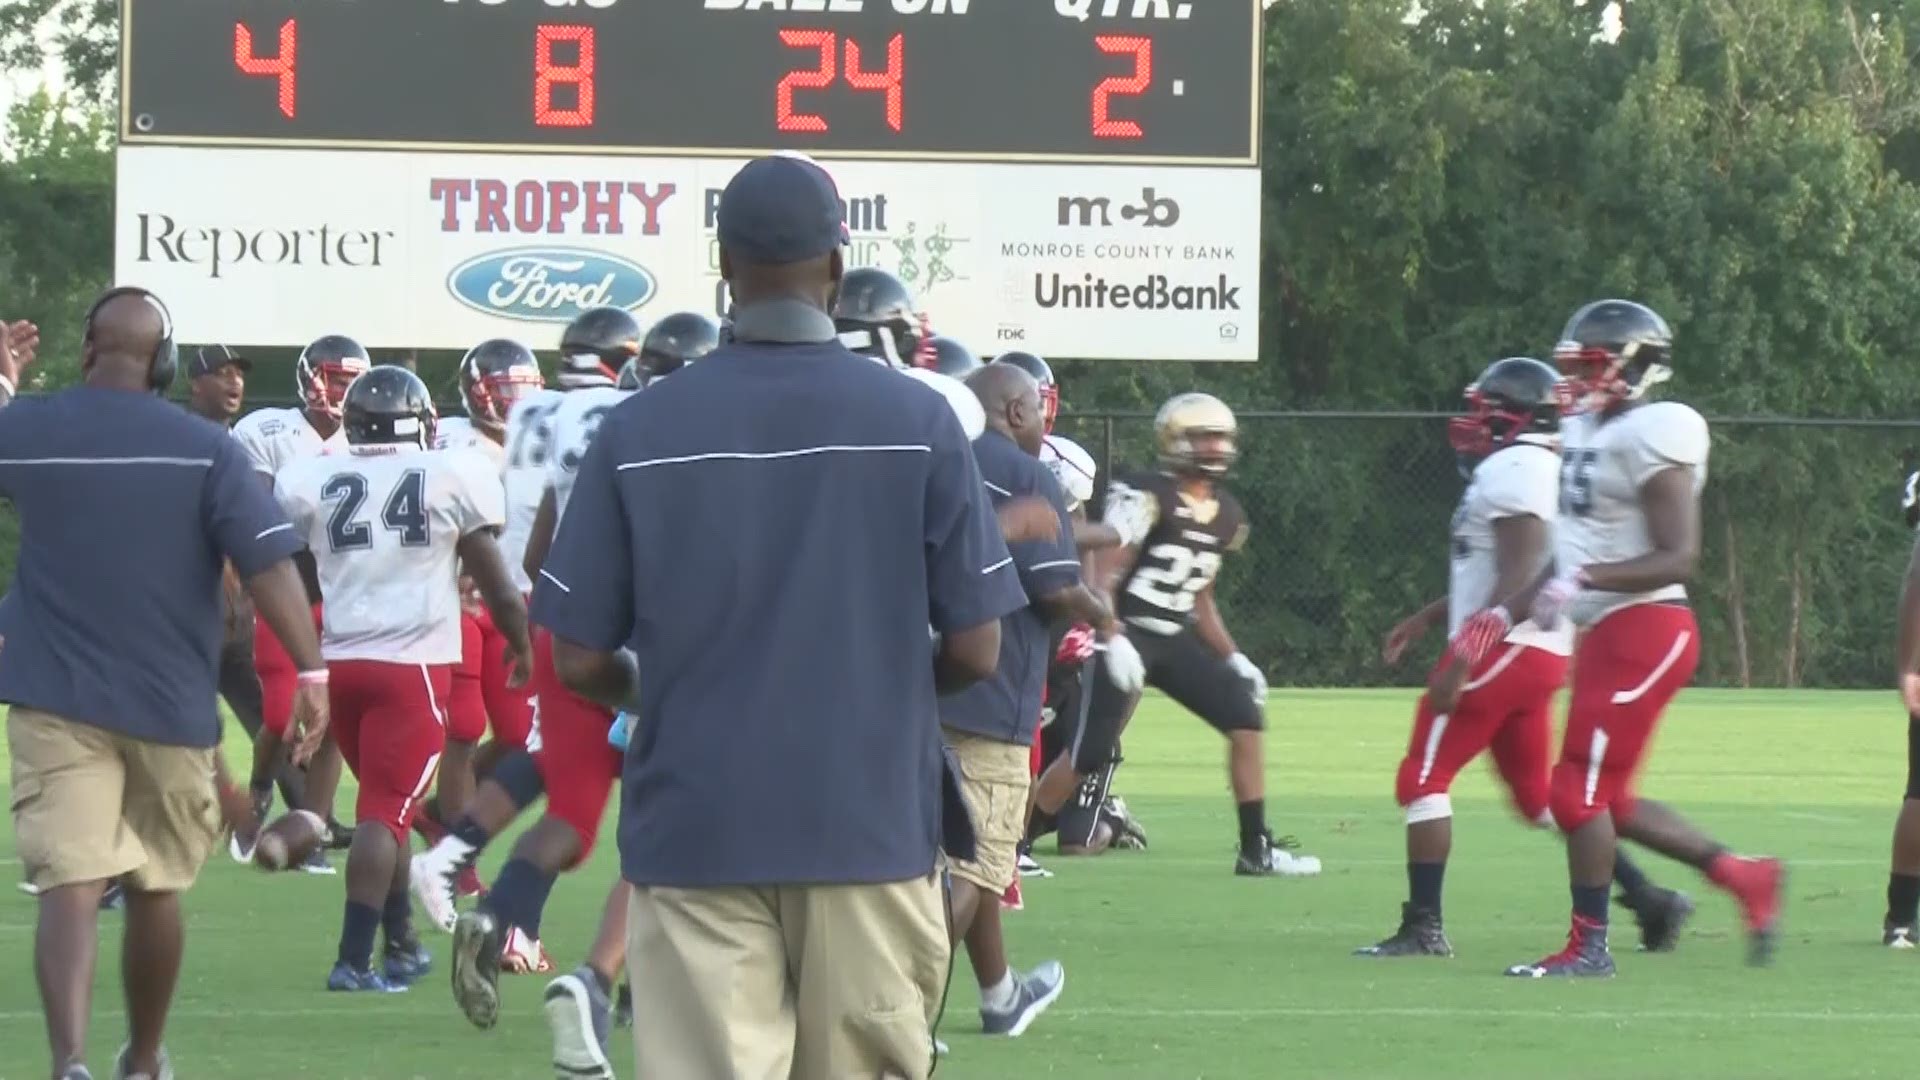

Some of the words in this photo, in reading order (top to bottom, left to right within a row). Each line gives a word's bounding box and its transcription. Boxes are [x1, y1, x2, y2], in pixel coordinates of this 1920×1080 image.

[234, 18, 296, 118] 4
[535, 23, 595, 127] 8
[776, 29, 903, 132] 24
[1092, 34, 1152, 138] 2
[429, 178, 677, 236] TROPHY
[136, 213, 395, 279] Reporter
[487, 255, 617, 309] Ford
[1000, 242, 1087, 259] MONROE
[1094, 243, 1174, 260] COUNTY
[1183, 245, 1236, 261] BANK
[1034, 272, 1241, 311] UnitedBank
[320, 468, 431, 554] 24
